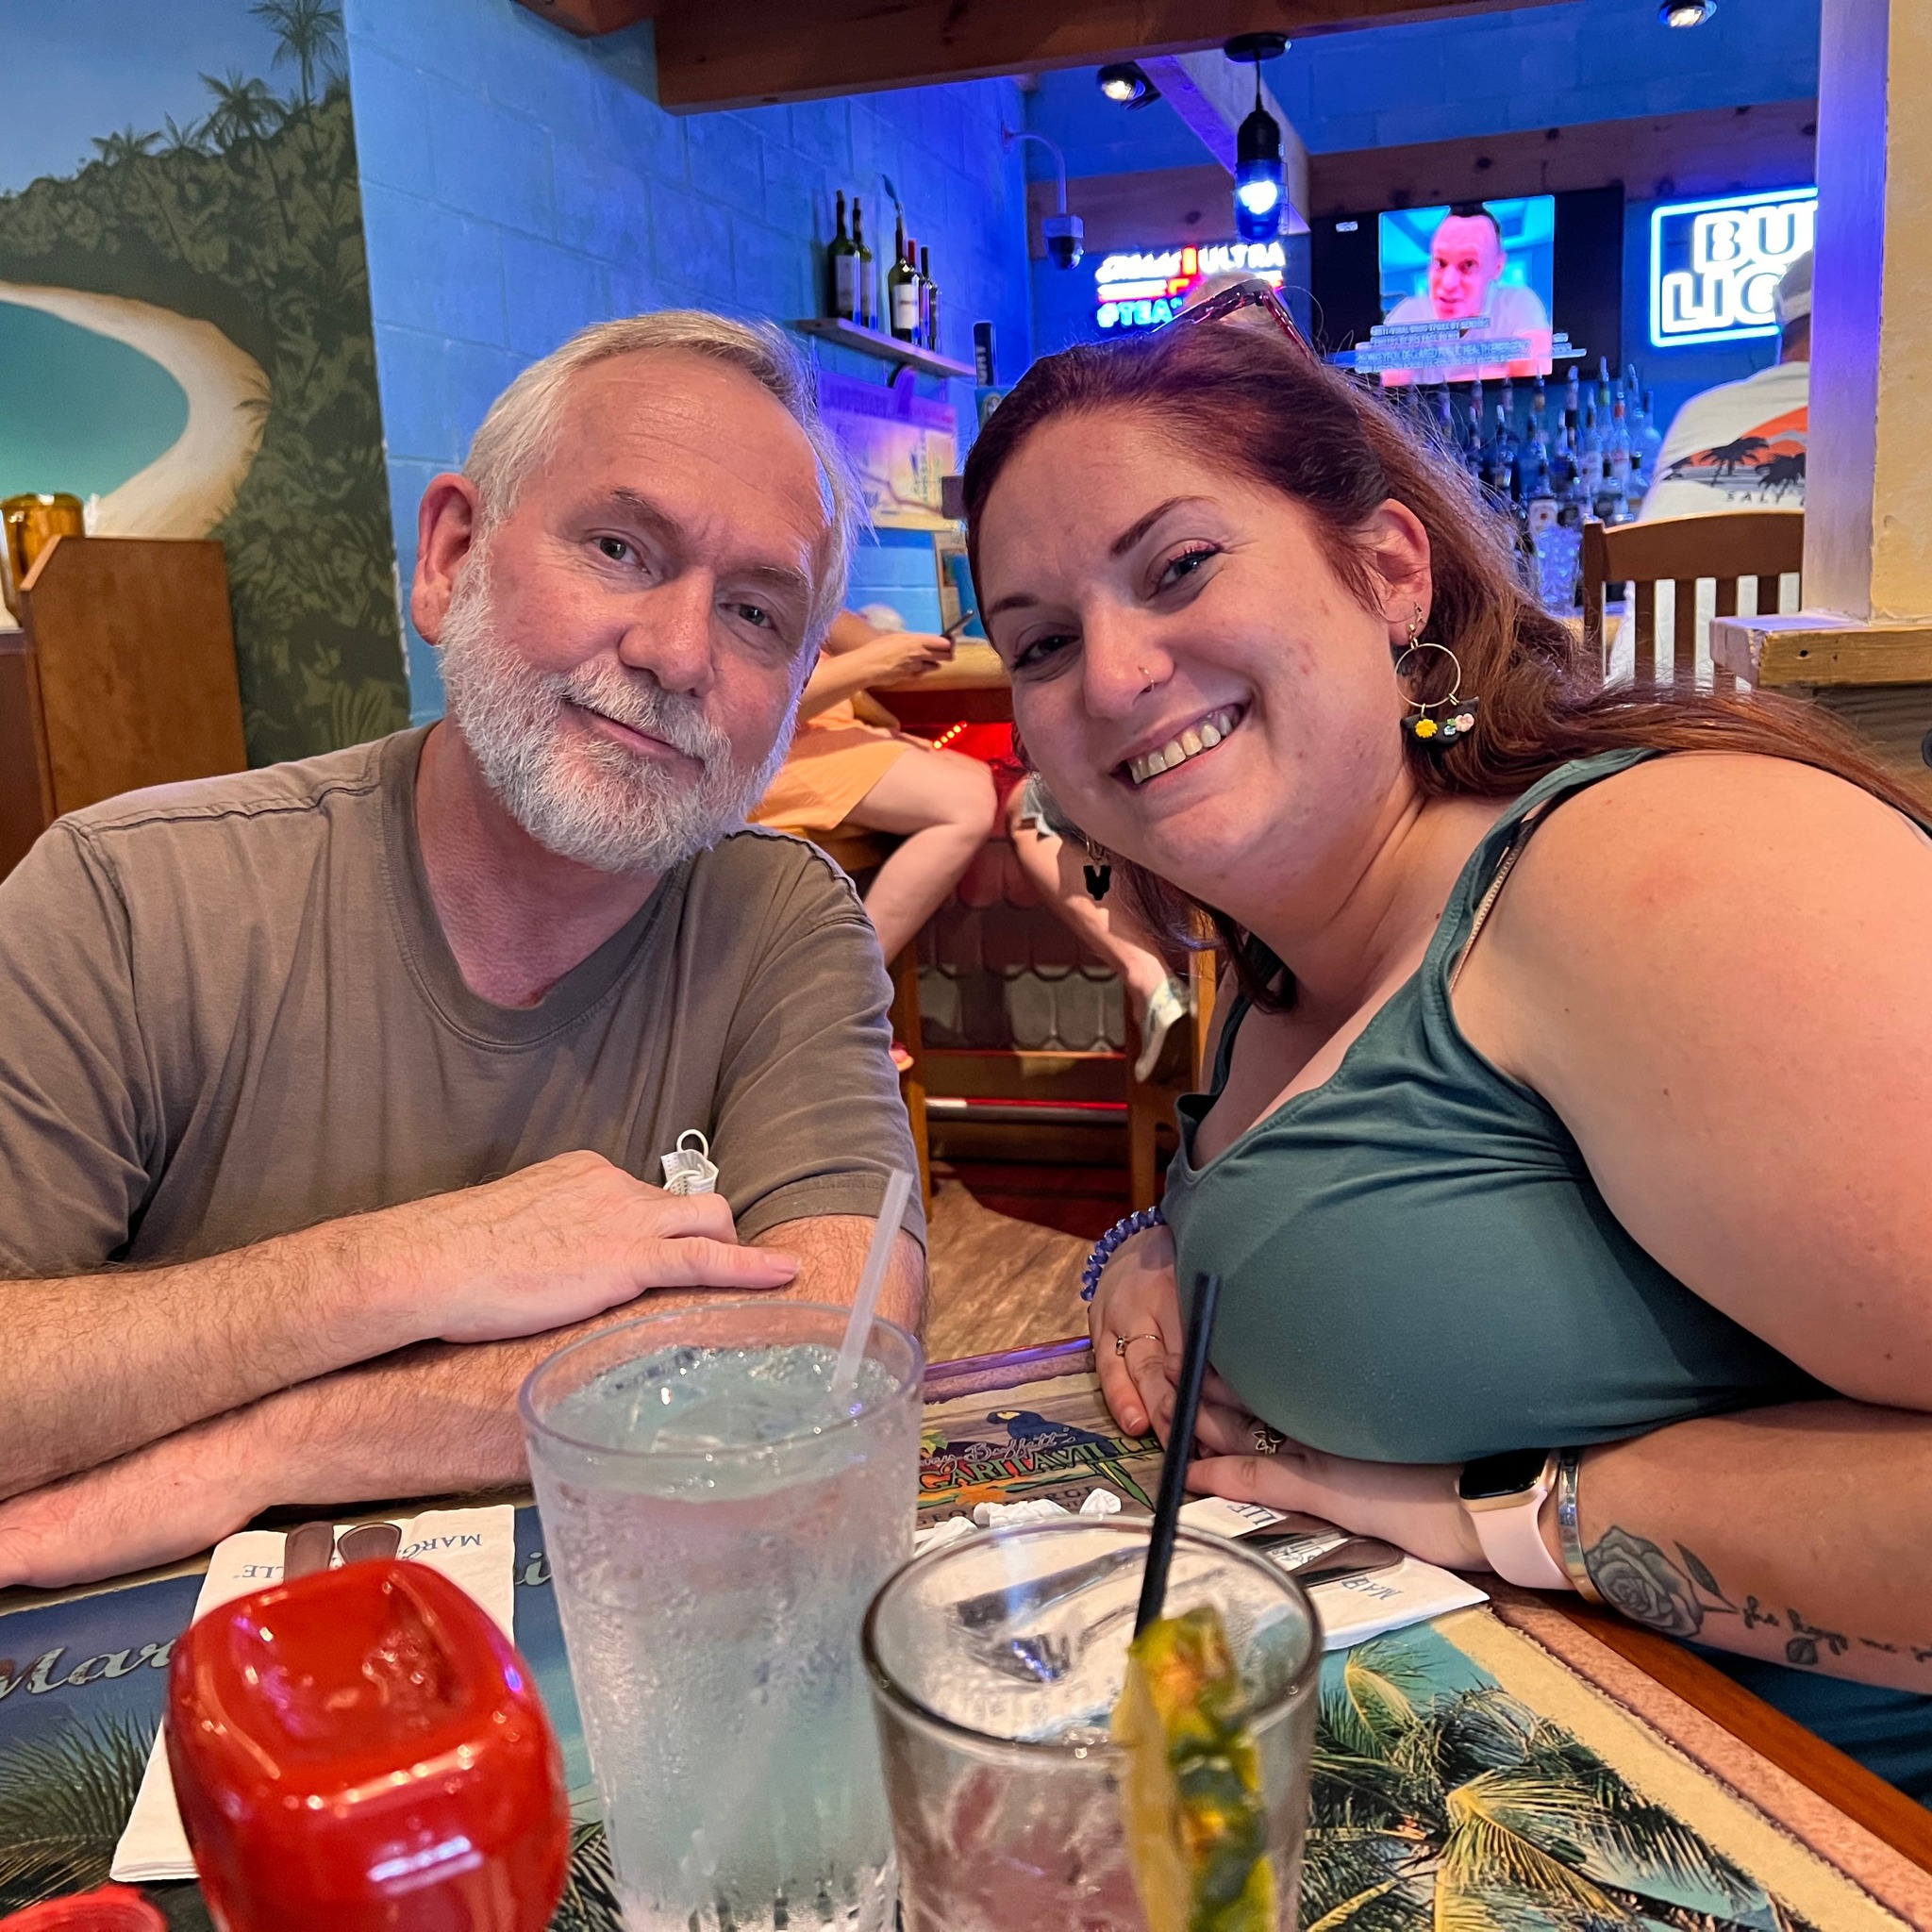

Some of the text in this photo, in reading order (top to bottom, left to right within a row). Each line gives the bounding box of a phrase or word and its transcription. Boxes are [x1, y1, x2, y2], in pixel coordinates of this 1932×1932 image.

[1198, 242, 1286, 274] ULTRA
[1694, 200, 1818, 274] BU
[1662, 254, 1786, 332] LIG
[397, 1534, 483, 1560] MARG
